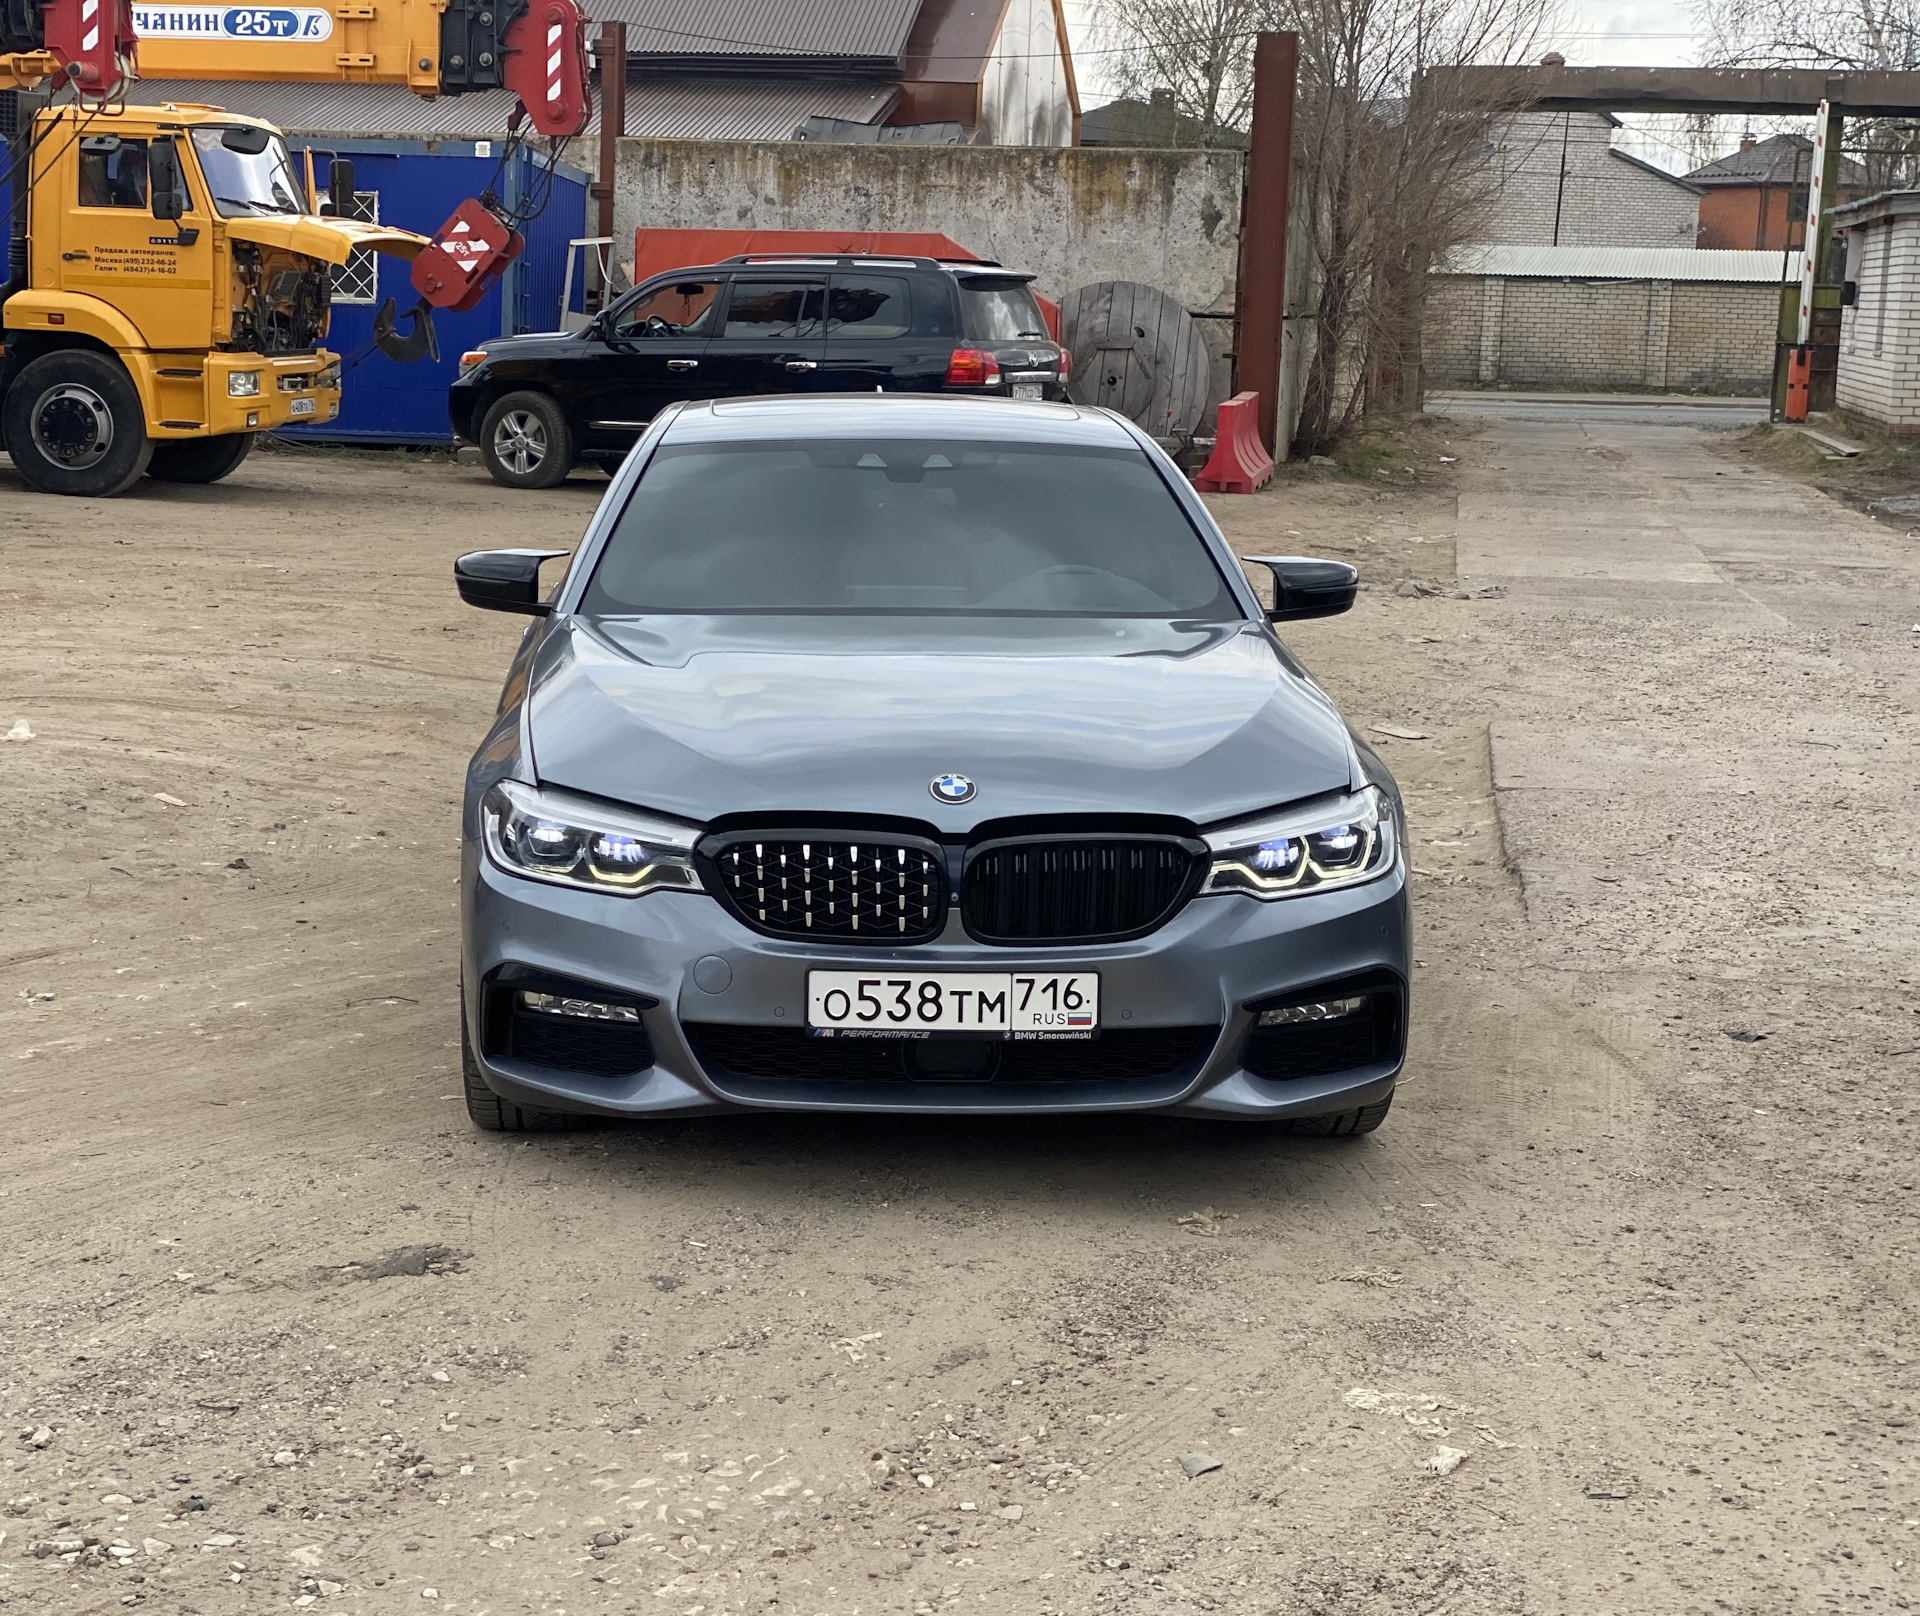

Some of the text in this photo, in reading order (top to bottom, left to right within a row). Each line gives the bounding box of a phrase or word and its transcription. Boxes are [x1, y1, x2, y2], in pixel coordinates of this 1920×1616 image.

[135, 12, 220, 32] ЧАНИН
[94, 246, 176, 256] Продажа автокранов:
[94, 256, 122, 264] Москва
[94, 264, 117, 272] Галич
[1016, 978, 1083, 1011] 716
[1033, 1013, 1066, 1025] RUS
[841, 1029, 931, 1039] PERFORMANCE
[1014, 1031, 1092, 1040] BMW Smorawiński
